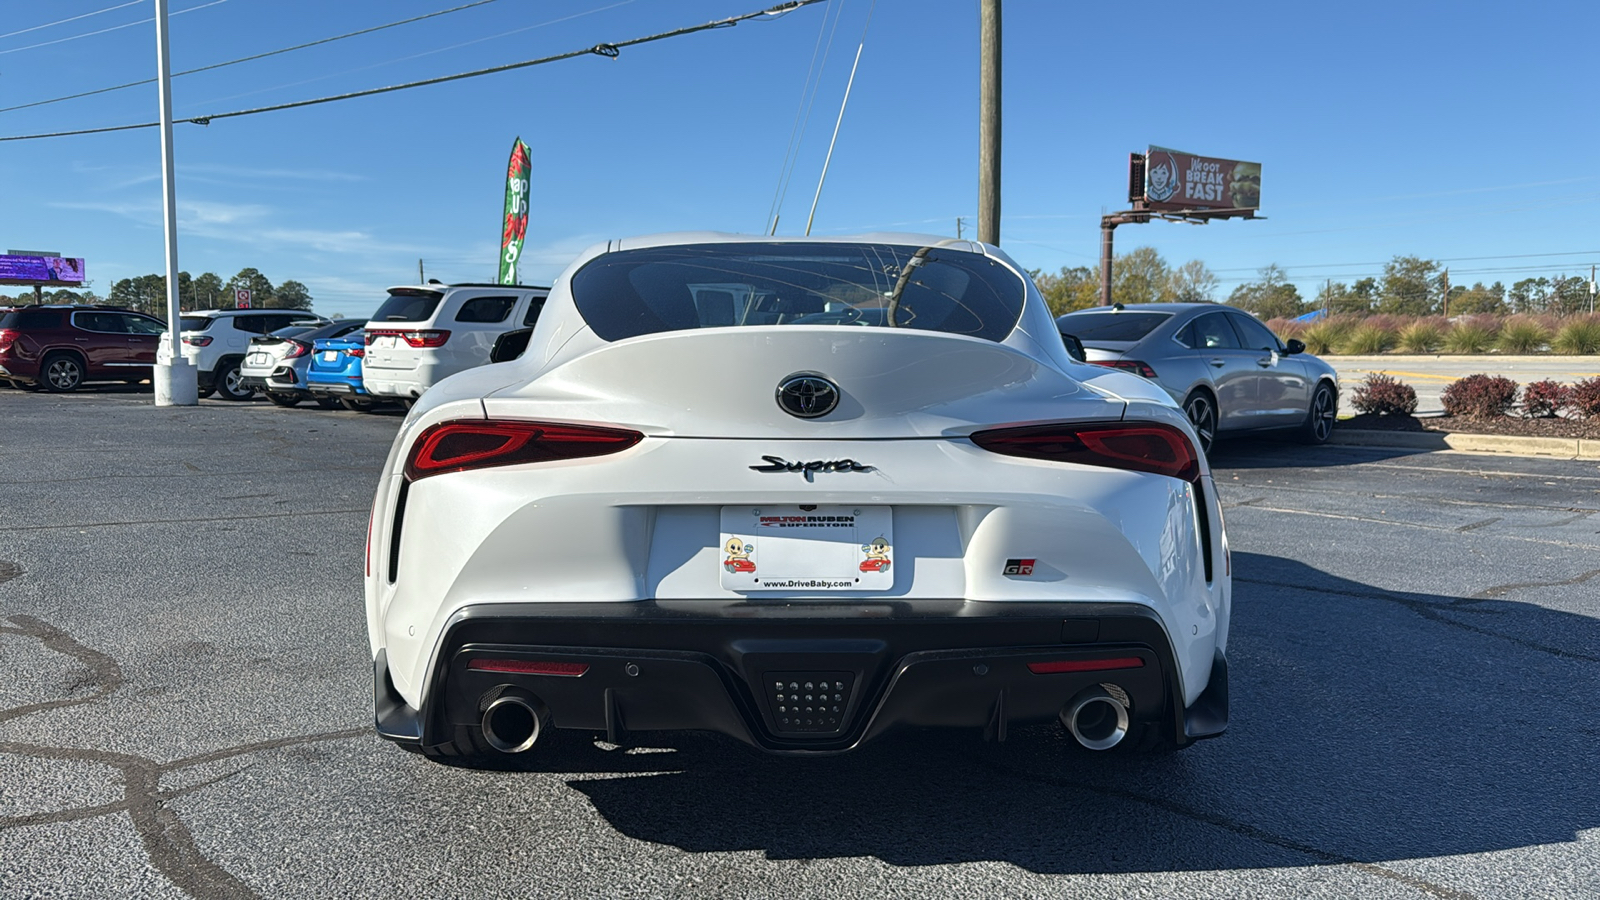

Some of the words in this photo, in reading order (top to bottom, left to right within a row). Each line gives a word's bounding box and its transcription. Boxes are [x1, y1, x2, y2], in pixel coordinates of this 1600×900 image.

[1186, 170, 1224, 185] BREAK
[1185, 183, 1224, 201] FAST
[748, 455, 873, 483] Supra
[760, 515, 806, 523] MILTON
[807, 515, 854, 523] RUBEN
[1004, 565, 1033, 576] GR
[763, 580, 852, 589] www.DriveBaby.com
